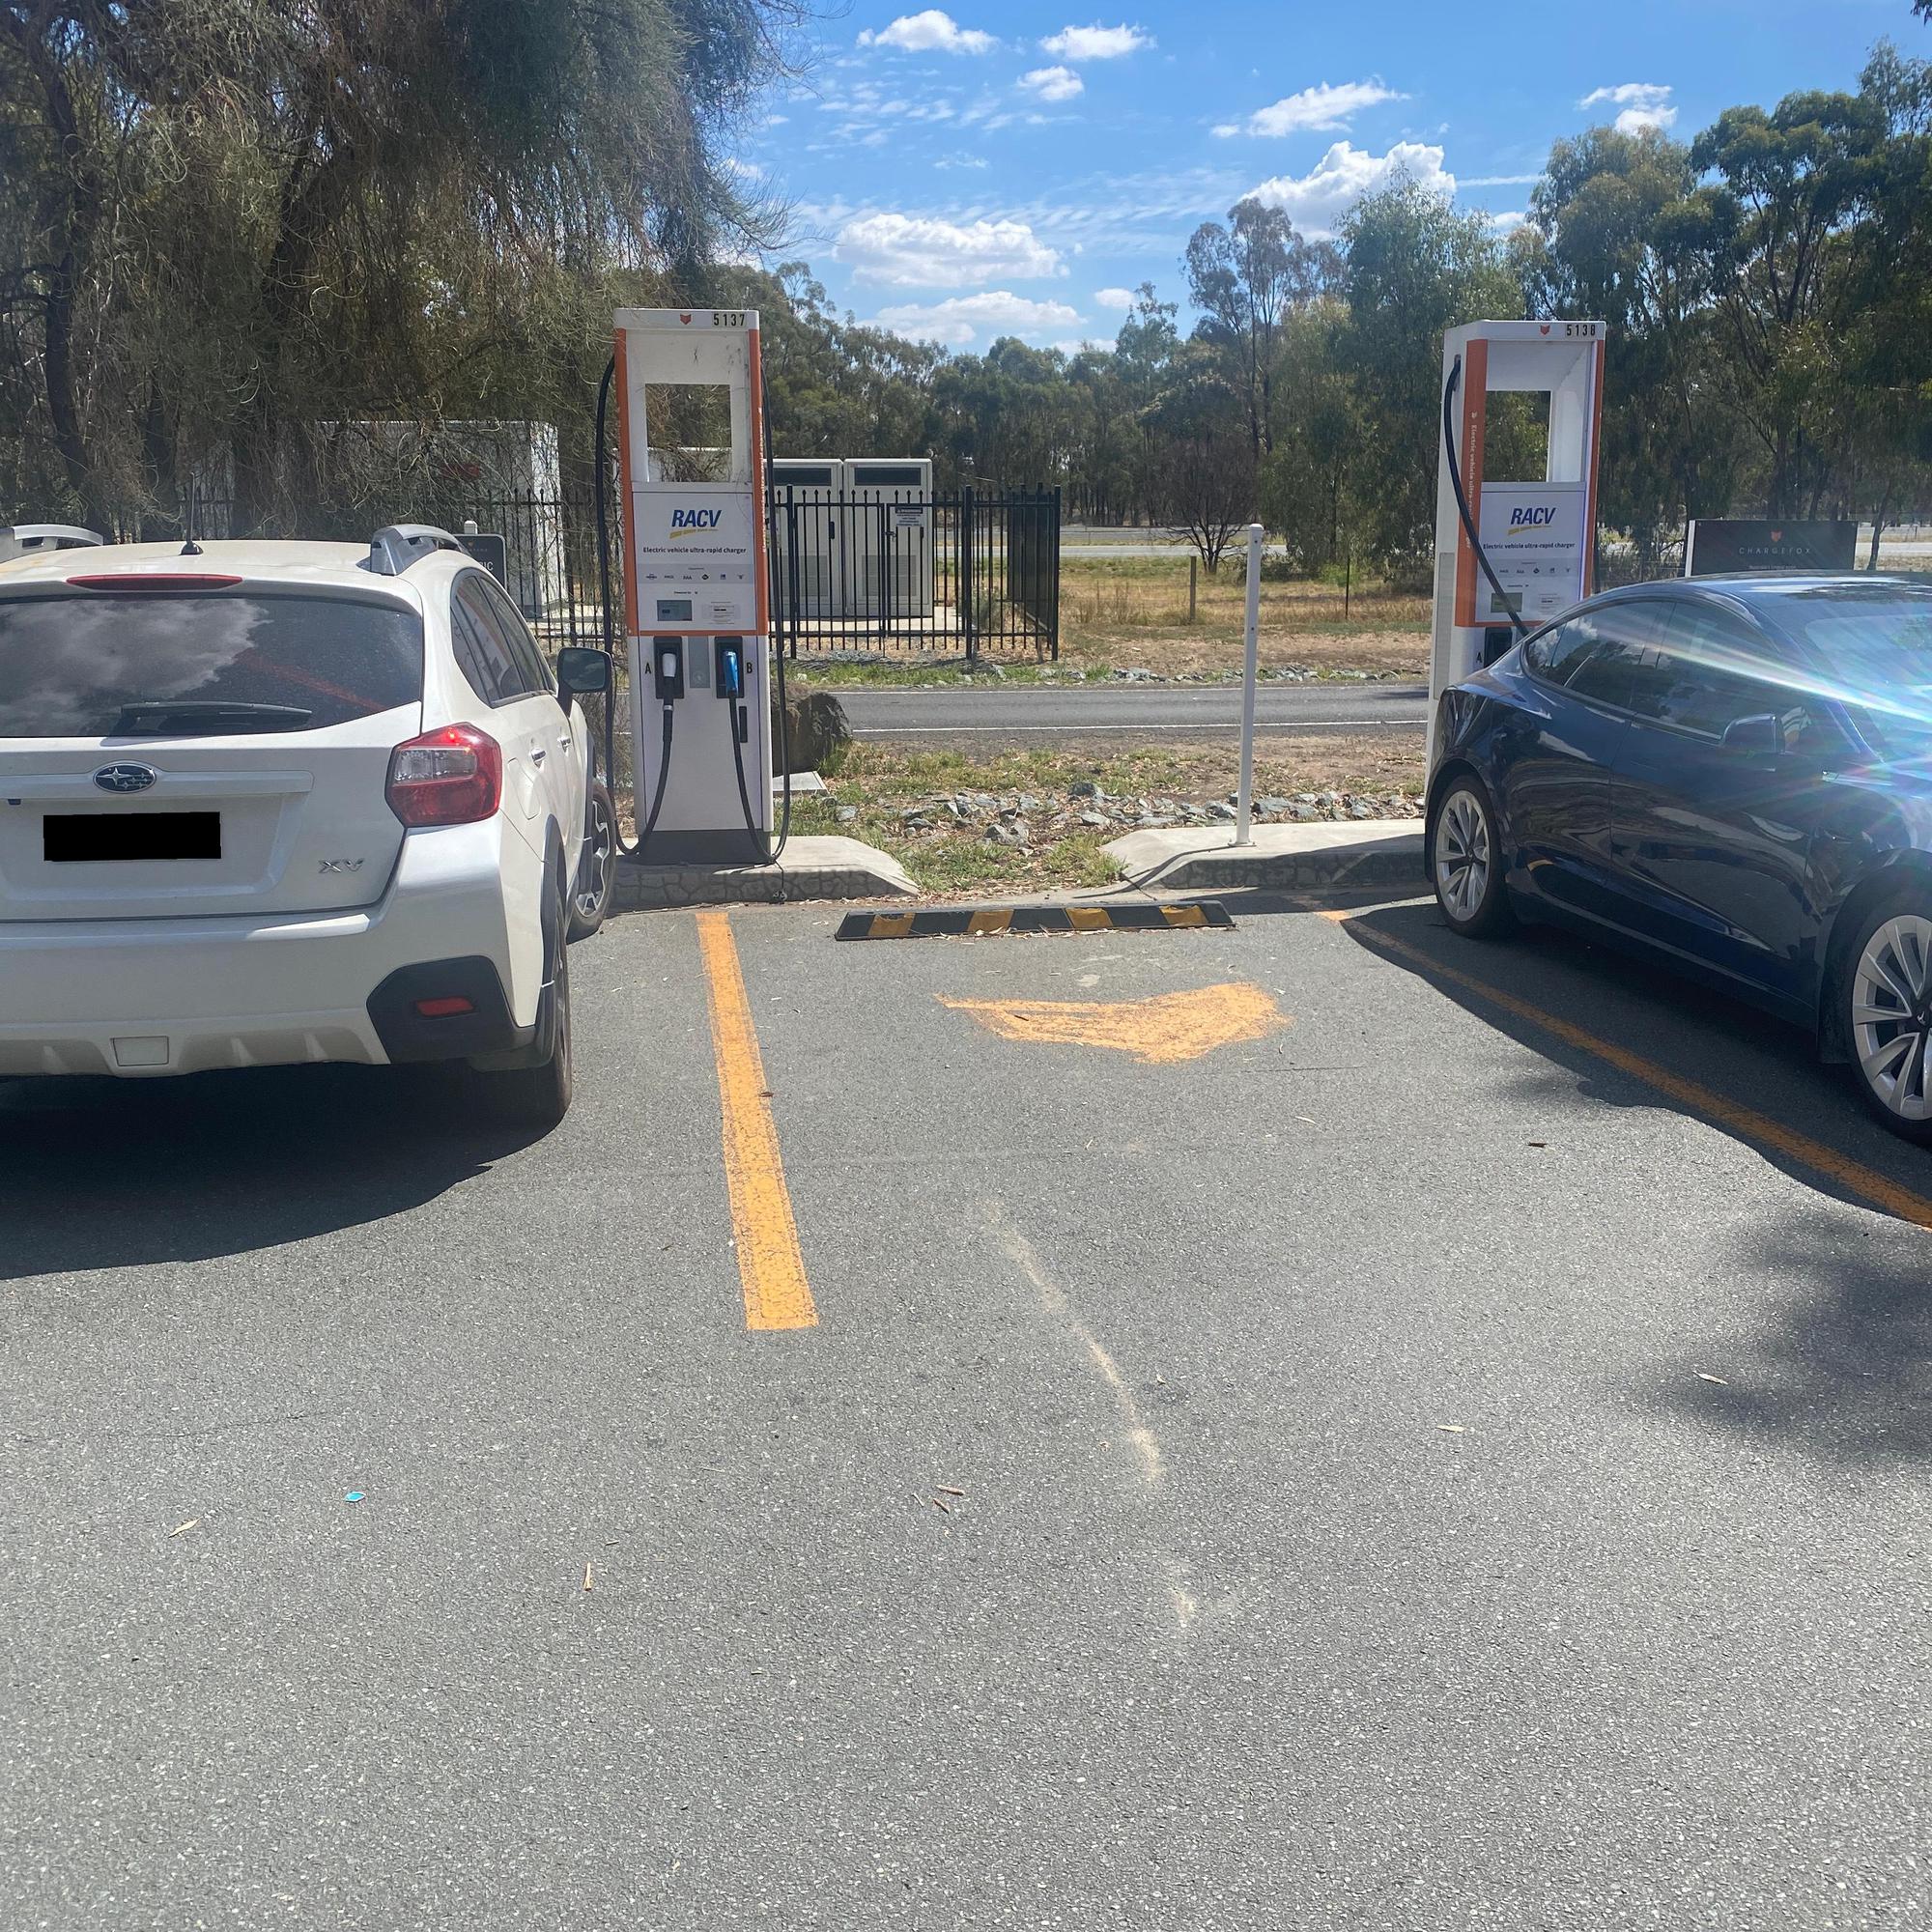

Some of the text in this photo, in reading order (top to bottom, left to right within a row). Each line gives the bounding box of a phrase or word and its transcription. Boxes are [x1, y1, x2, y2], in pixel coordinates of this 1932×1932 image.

[713, 313, 745, 327] 5137
[1566, 324, 1596, 336] 5138
[671, 509, 723, 527] RACV
[1510, 507, 1556, 525] RACV
[1524, 542, 1554, 551] ultra-rapid
[1476, 652, 1483, 664] A
[644, 663, 652, 674] A
[746, 662, 753, 674] B
[318, 858, 364, 873] XV
